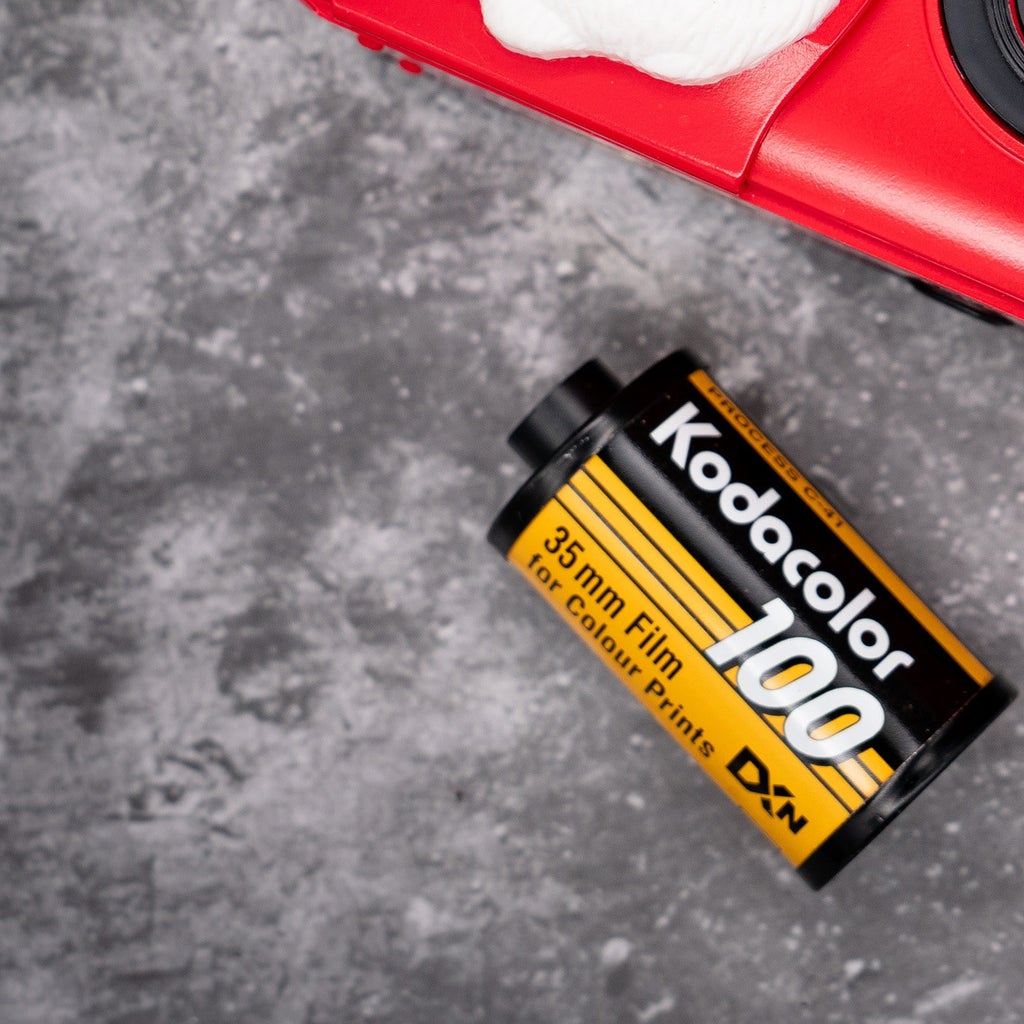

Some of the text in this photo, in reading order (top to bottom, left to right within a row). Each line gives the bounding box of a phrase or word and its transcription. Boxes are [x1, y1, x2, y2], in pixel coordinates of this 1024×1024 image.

[707, 386, 845, 529] PROCESS C-41
[648, 401, 915, 682] Kodacolor
[527, 553, 715, 758] for Colour Prints
[624, 611, 684, 680] Film
[704, 597, 886, 763] 100
